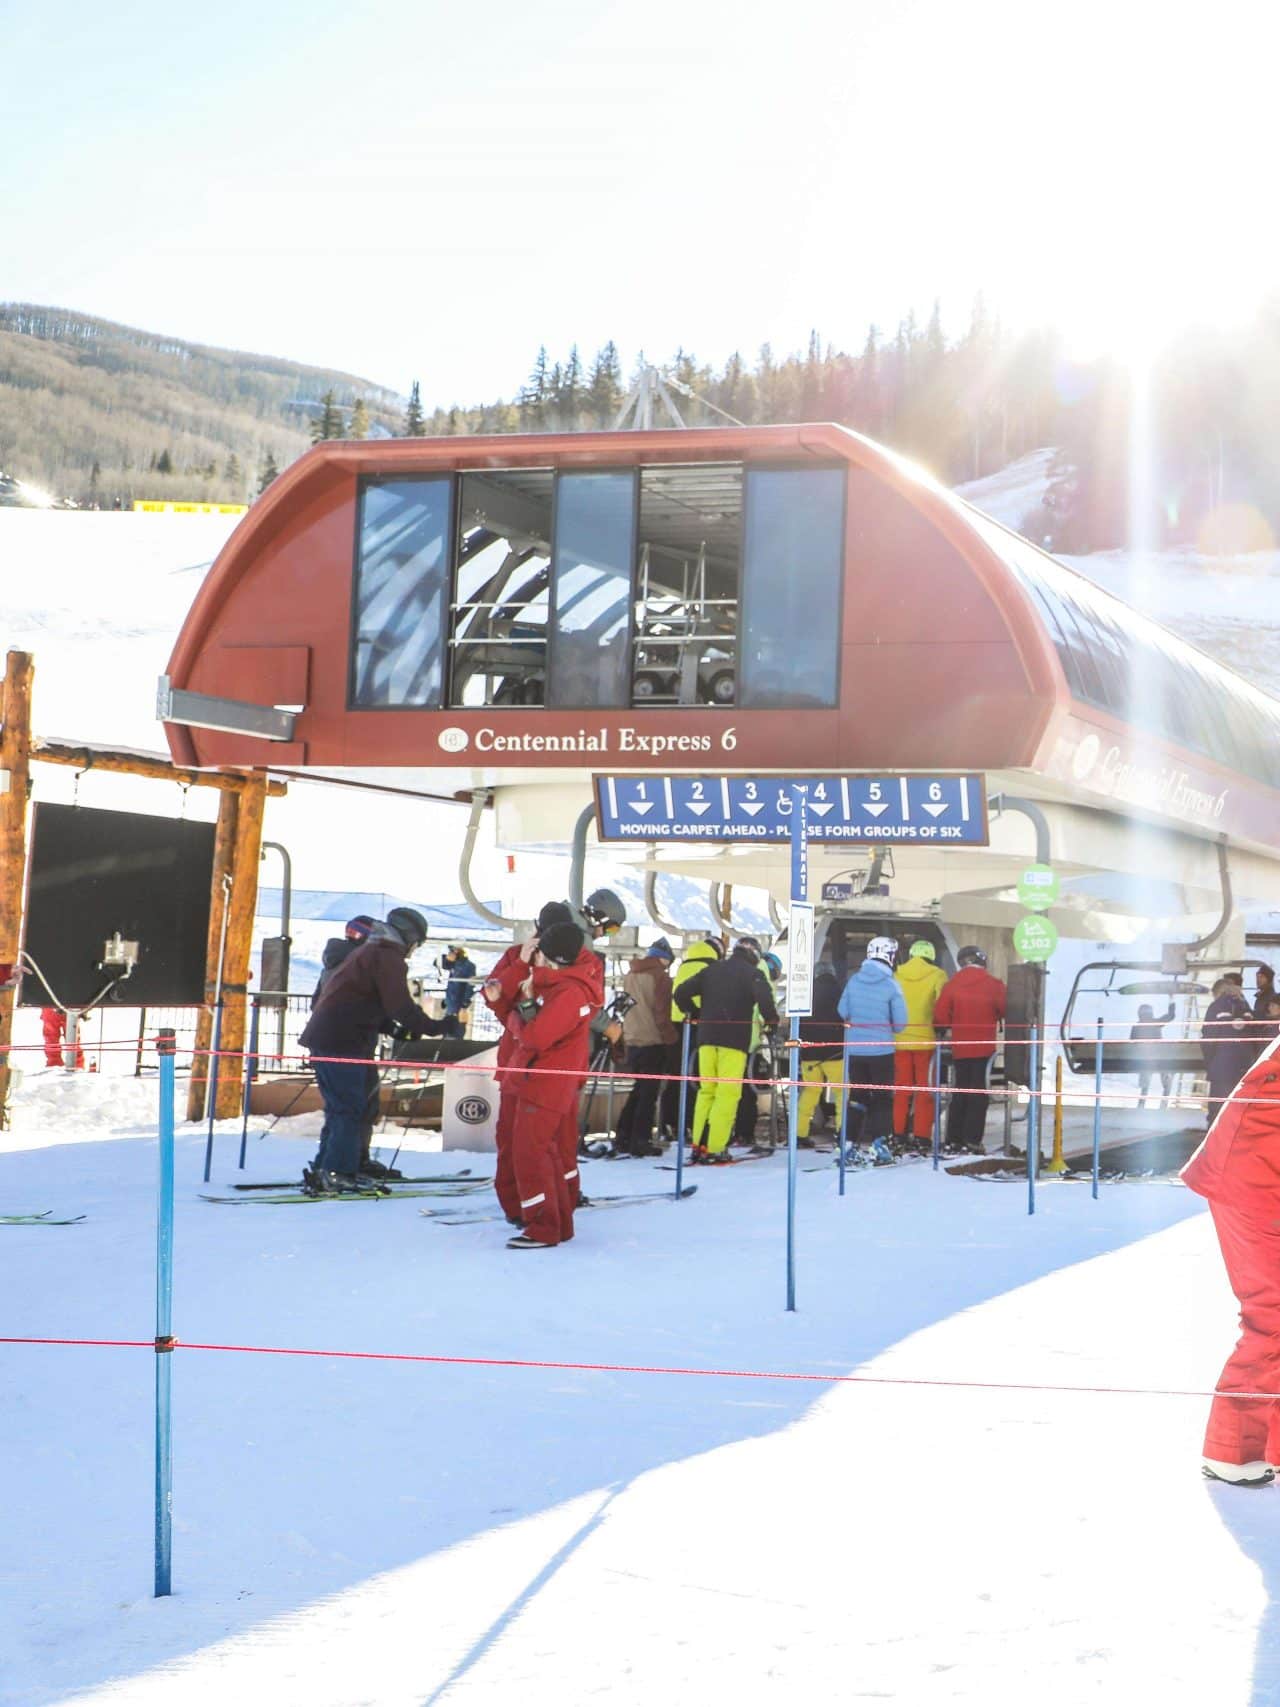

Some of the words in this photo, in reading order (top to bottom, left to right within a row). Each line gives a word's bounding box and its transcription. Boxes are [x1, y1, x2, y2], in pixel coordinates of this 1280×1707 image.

[475, 728, 607, 751] Centennial
[619, 728, 711, 755] Express
[721, 728, 737, 751] 6
[636, 781, 647, 800] 1
[691, 781, 705, 800] 2
[745, 781, 758, 800] 3
[814, 782, 827, 801] 4
[869, 782, 882, 801] 5
[929, 782, 942, 801] 6
[620, 823, 670, 835] MOVING
[672, 824, 720, 836] CARPET
[722, 824, 766, 836] AHEAD
[776, 825, 823, 837] PLSE
[825, 825, 861, 837] FORM
[863, 826, 917, 838] GROUPS
[919, 826, 937, 838] OF
[940, 826, 962, 838] SIX
